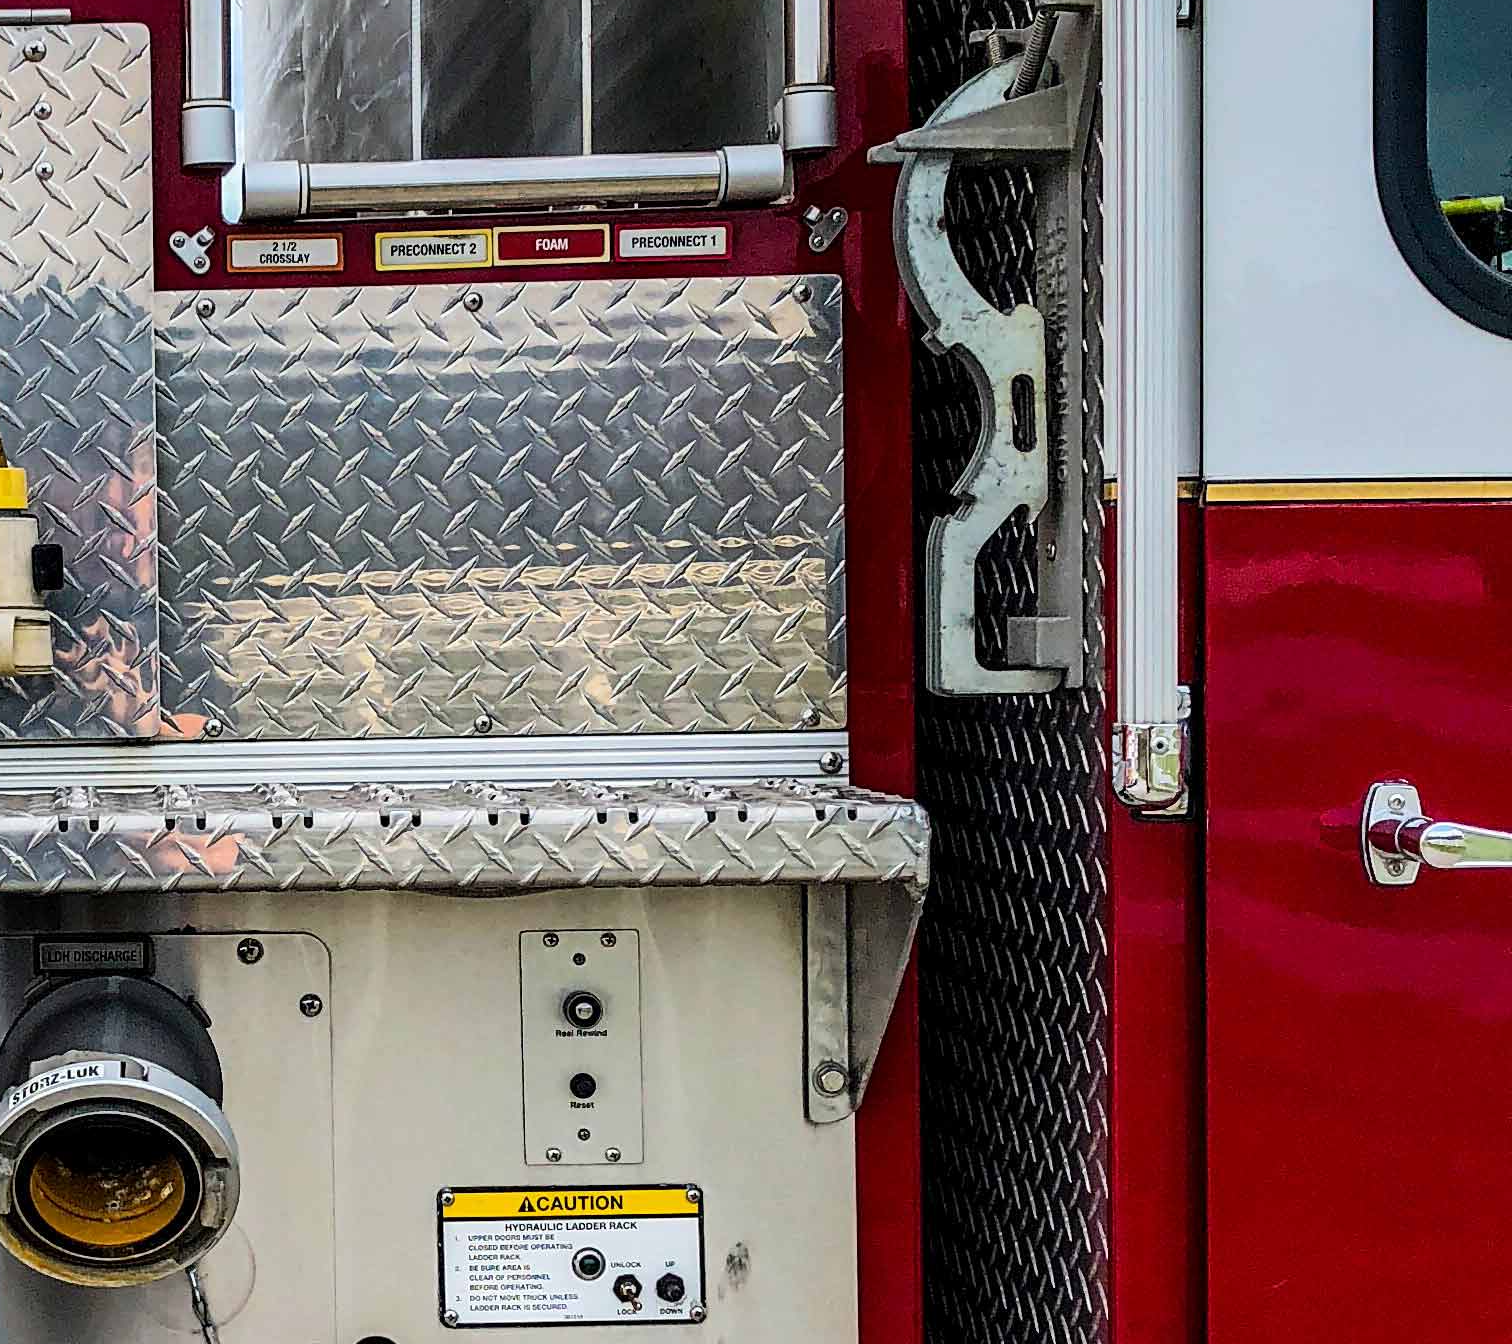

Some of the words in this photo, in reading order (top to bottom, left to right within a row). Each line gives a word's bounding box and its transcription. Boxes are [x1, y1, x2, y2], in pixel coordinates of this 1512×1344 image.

[272, 242, 279, 252] 2
[282, 241, 297, 252] 1/2
[535, 238, 569, 251] FOAM
[631, 235, 707, 249] PRECONNECT
[710, 235, 717, 246] 1
[390, 243, 466, 257] PRECONNECT
[469, 243, 477, 255] 2
[259, 253, 310, 264] CROSSLAY
[47, 950, 69, 963] LDH
[73, 949, 137, 962] DISCHARGE
[570, 1101, 595, 1109] Reset
[536, 1195, 624, 1212] CAUTION
[504, 1221, 564, 1232] HYDRAULIC
[565, 1221, 607, 1231] LADDER
[609, 1221, 638, 1230] RACK
[468, 1234, 493, 1242] UPPER
[481, 1264, 500, 1272] SURE
[507, 1273, 551, 1281] PERSONNEL
[549, 1293, 579, 1301] UNLESS
[470, 1304, 500, 1312] LADDER
[617, 1308, 638, 1316] LOCK
